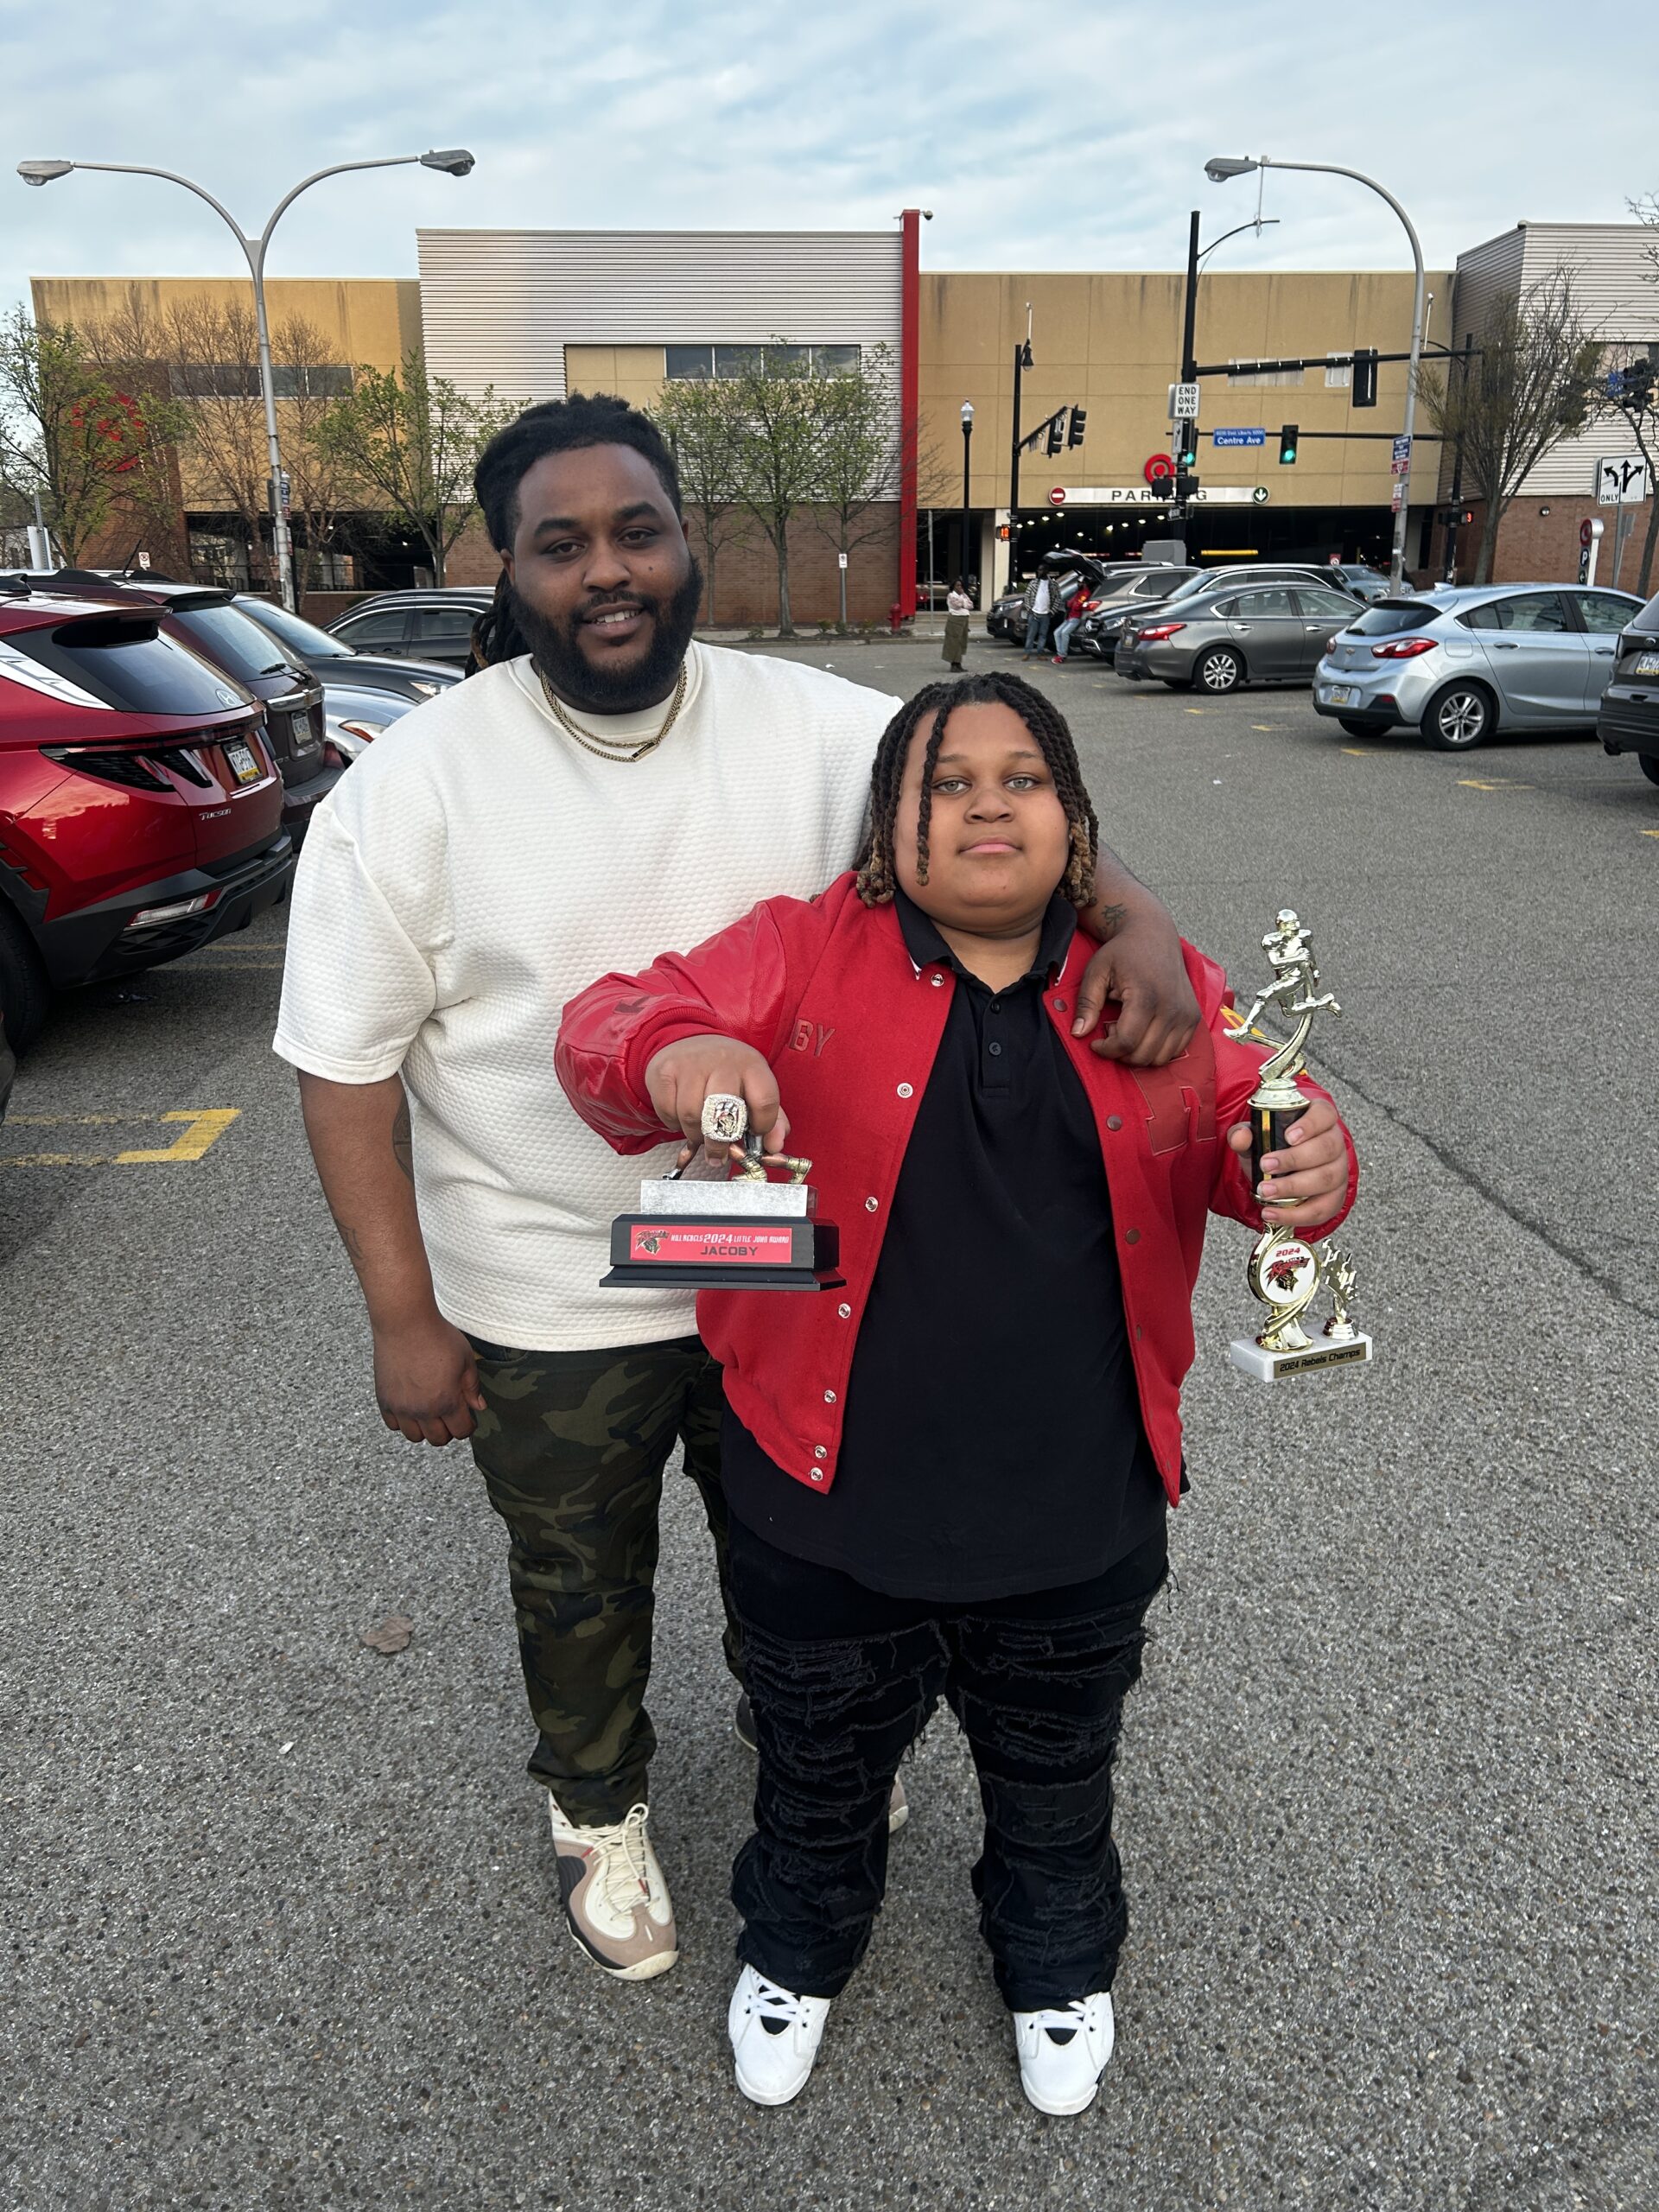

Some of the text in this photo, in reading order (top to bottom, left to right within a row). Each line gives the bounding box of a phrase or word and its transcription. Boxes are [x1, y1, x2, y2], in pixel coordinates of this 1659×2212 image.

[1179, 386, 1197, 395] END
[1217, 436, 1244, 445] Centre
[1111, 490, 1207, 501] PARG
[1600, 493, 1619, 503] ONLY
[703, 1233, 733, 1243] 2024
[701, 1246, 759, 1255] JACOBY
[1275, 1247, 1300, 1257] 2024
[1280, 1349, 1361, 1371] 2024 Rebels Champs
